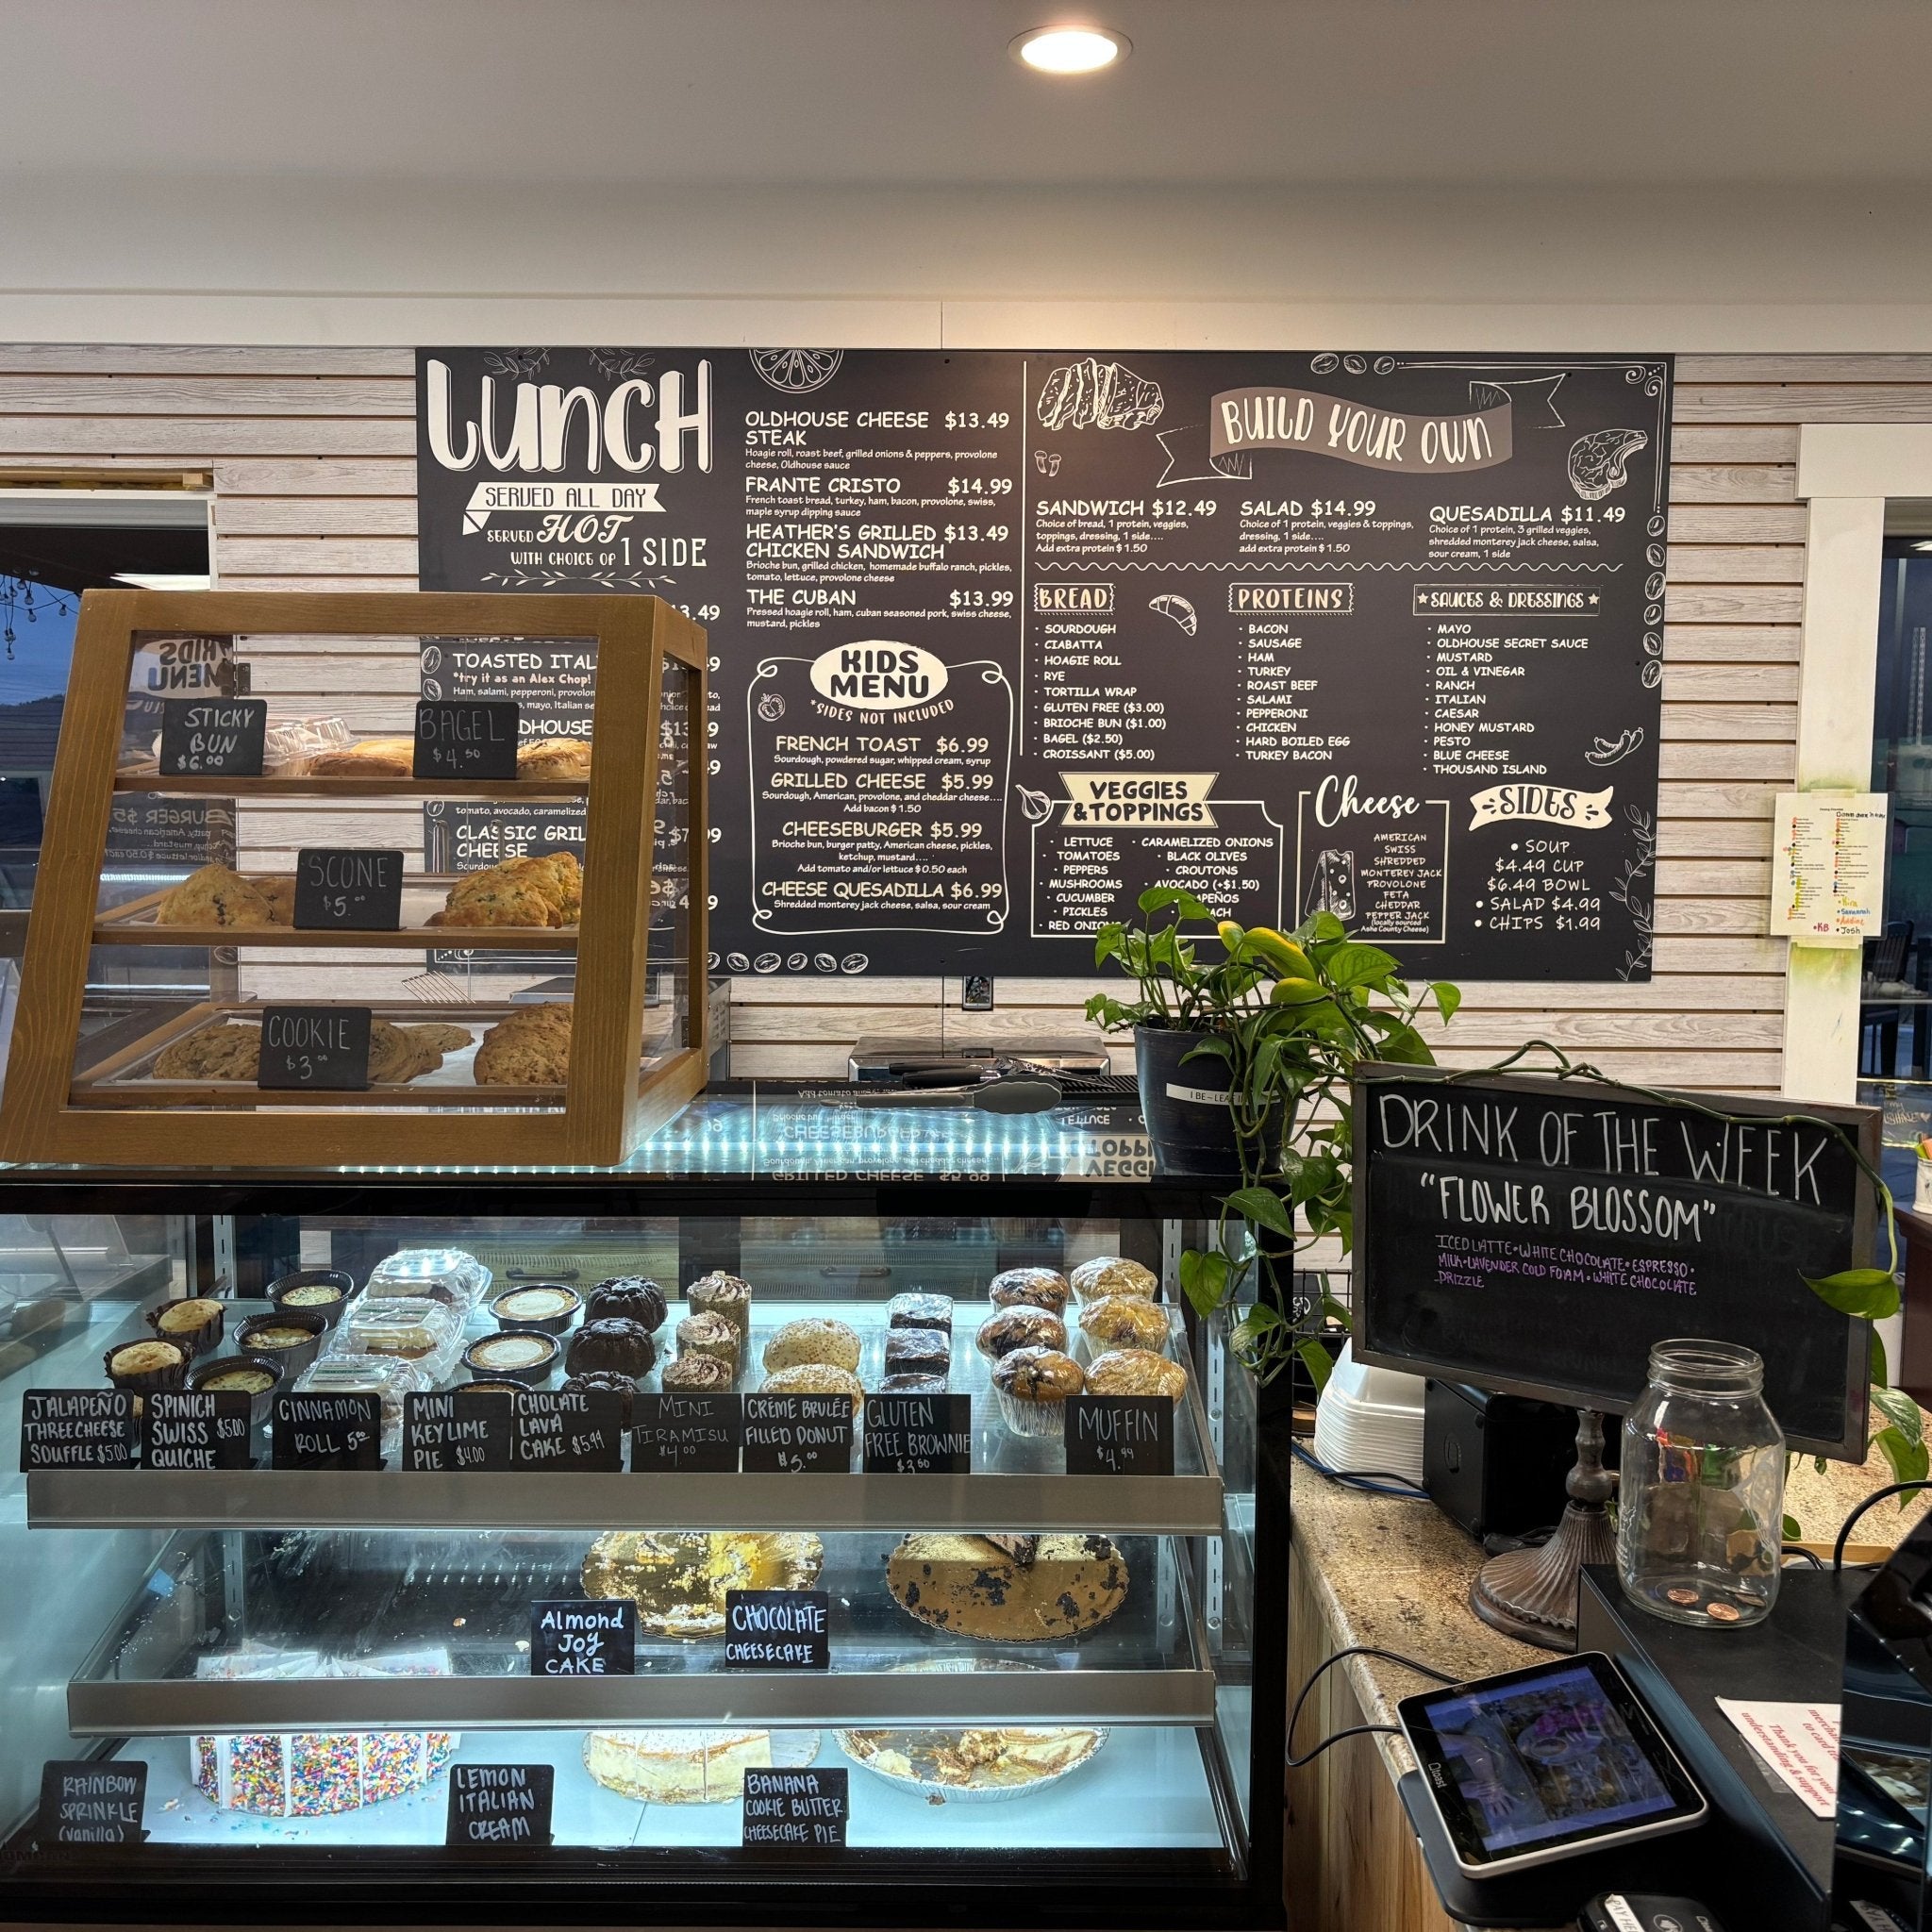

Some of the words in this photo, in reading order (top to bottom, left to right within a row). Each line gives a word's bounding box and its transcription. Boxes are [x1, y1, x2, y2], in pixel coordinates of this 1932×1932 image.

[745, 411, 849, 427] OLDHOUSE
[857, 412, 929, 428] CHEESE
[945, 411, 1009, 430] $13.49
[1221, 396, 1314, 444] BUILD
[1327, 404, 1406, 462] YOUR
[1421, 416, 1492, 464] OWN
[745, 430, 807, 446] STEAK
[745, 449, 775, 458] Hoagie
[777, 449, 794, 458] roll,
[796, 450, 821, 458] roast
[823, 449, 844, 458] beef,
[845, 450, 874, 459] grilled
[874, 450, 904, 458] onions
[906, 450, 912, 458] &
[914, 451, 953, 460] peppers,
[955, 450, 997, 460] provolone
[745, 477, 821, 493] FRANTE
[828, 478, 901, 493] CRISTO
[948, 477, 1013, 496] $14.99
[486, 488, 554, 508] SERVED
[566, 488, 600, 508] ALL
[613, 489, 646, 508] DAY
[1036, 500, 1144, 516] SANDWICH
[1152, 499, 1217, 519] $12.49
[1240, 500, 1303, 517] SALAD
[1310, 499, 1376, 519] $14.99
[1429, 506, 1553, 524] QUESADILLA
[1561, 505, 1625, 525] $11.49
[536, 514, 634, 543] HOT
[746, 524, 850, 541] HEATHER'S
[858, 525, 936, 541] GRILLED
[944, 525, 1008, 543] $13.49
[510, 552, 542, 565] WITH
[621, 538, 630, 566] 1
[642, 538, 708, 567] SIDE
[746, 542, 829, 558] CHICKEN
[838, 543, 944, 559] SANDWICH
[1039, 588, 1108, 609] BREAD
[1238, 588, 1342, 609] PROTEINS
[1430, 592, 1484, 608] SAUCES
[1489, 591, 1503, 608] &
[1508, 592, 1584, 608] DRESSINGS
[1044, 625, 1116, 634] SOURDOUGH
[1249, 625, 1289, 634] BACON
[1438, 625, 1471, 634] MAYO
[453, 653, 542, 670] TOASTED
[841, 650, 919, 674] KIDS
[481, 674, 491, 683] it
[494, 675, 508, 683] as
[512, 675, 525, 683] an
[530, 674, 555, 684] Alex
[559, 674, 591, 687] Chop!
[830, 675, 929, 698] MENU
[185, 708, 255, 728] STICKY
[860, 712, 885, 724] NOT
[893, 699, 955, 724] INCLUDED
[1043, 703, 1088, 712] GLUTEN
[1092, 703, 1120, 712] FREE
[1124, 702, 1164, 714] ($3.00)
[419, 708, 505, 741] BAGEL
[190, 734, 237, 754] BUN
[776, 736, 848, 752] FRENCH
[857, 737, 921, 752] TOAST
[936, 736, 989, 755] $6.99
[771, 773, 847, 789] GRILLED
[856, 773, 926, 790] CHEESE
[941, 773, 993, 792] $5.99
[1090, 780, 1188, 800] VEGGIES
[1315, 774, 1420, 827] Cheese
[1499, 787, 1577, 820] SIDES
[1064, 837, 1113, 847] LETTUCE
[1374, 833, 1427, 841] AMERICAN
[1525, 841, 1570, 853] SOUP
[1385, 845, 1416, 854] SWISS
[308, 855, 388, 889] SCONE
[1495, 857, 1545, 873] $4.49
[1553, 860, 1584, 873] CUP
[1155, 880, 1208, 890] AVOCADO
[1212, 879, 1259, 891] (+$1.50)
[269, 1015, 351, 1050] COOKIE
[1379, 1093, 1519, 1163] DRINK
[1541, 1110, 1584, 1167] OF
[1593, 1110, 1660, 1177] THE
[1436, 1234, 1469, 1251] ICED
[1472, 1238, 1513, 1256] LATTE
[1519, 1241, 1557, 1260] WHITE
[1559, 1247, 1624, 1272] CHOCOLATE
[1632, 1260, 1688, 1277] ESPRESSO
[1438, 1255, 1462, 1268] MILK
[1467, 1257, 1520, 1274] LAVENDER
[1523, 1262, 1545, 1276] COLD
[1549, 1266, 1584, 1283] FOAM
[1592, 1273, 1628, 1287] WHITE
[1630, 1274, 1696, 1296] CHOCOLATE
[28, 1391, 126, 1420] JALAPEÑO
[151, 1393, 215, 1419] SPINICH
[278, 1397, 372, 1424] CINNAMON
[413, 1395, 454, 1421] MINI
[658, 1395, 715, 1419] MINI
[867, 1397, 933, 1428] GLUTEN
[24, 1422, 73, 1442] THREE
[75, 1422, 125, 1439] CHEESE
[151, 1421, 208, 1445] SWISS
[411, 1422, 445, 1447] KEY
[447, 1421, 489, 1441] LIME
[520, 1414, 562, 1436] LAVA
[633, 1424, 728, 1444] TIRAMISU
[1079, 1406, 1158, 1442] MUFFIN
[294, 1433, 341, 1455] ROLL
[745, 1425, 791, 1446] FILLED
[796, 1425, 848, 1446] DONUT
[864, 1432, 904, 1457] FREE
[908, 1432, 971, 1457] BROWNIE
[30, 1444, 93, 1464] SOUFFLE
[151, 1448, 216, 1470] QUICHE
[520, 1437, 566, 1460] CAKE
[413, 1449, 442, 1470] PIE
[541, 1607, 624, 1630] Almond
[732, 1604, 826, 1634] CHOCOLATE
[558, 1632, 605, 1657] Joy
[545, 1656, 605, 1674] CAKE
[1741, 1712, 1792, 1770] understanding
[1794, 1775, 1830, 1807] support
[1770, 1724, 1796, 1748] Thank
[1789, 1746, 1808, 1764] you
[1804, 1764, 1819, 1776] for
[62, 1774, 137, 1796] RAINBOW
[457, 1768, 526, 1790] LEMON
[747, 1773, 819, 1794] BANANA
[458, 1788, 536, 1814] ITALIAN
[745, 1799, 785, 1818] COOKIE
[791, 1797, 843, 1819] BUTTER
[59, 1802, 139, 1823] SPRINKLE
[469, 1815, 531, 1840] CREAM
[813, 1824, 841, 1843] PIE
